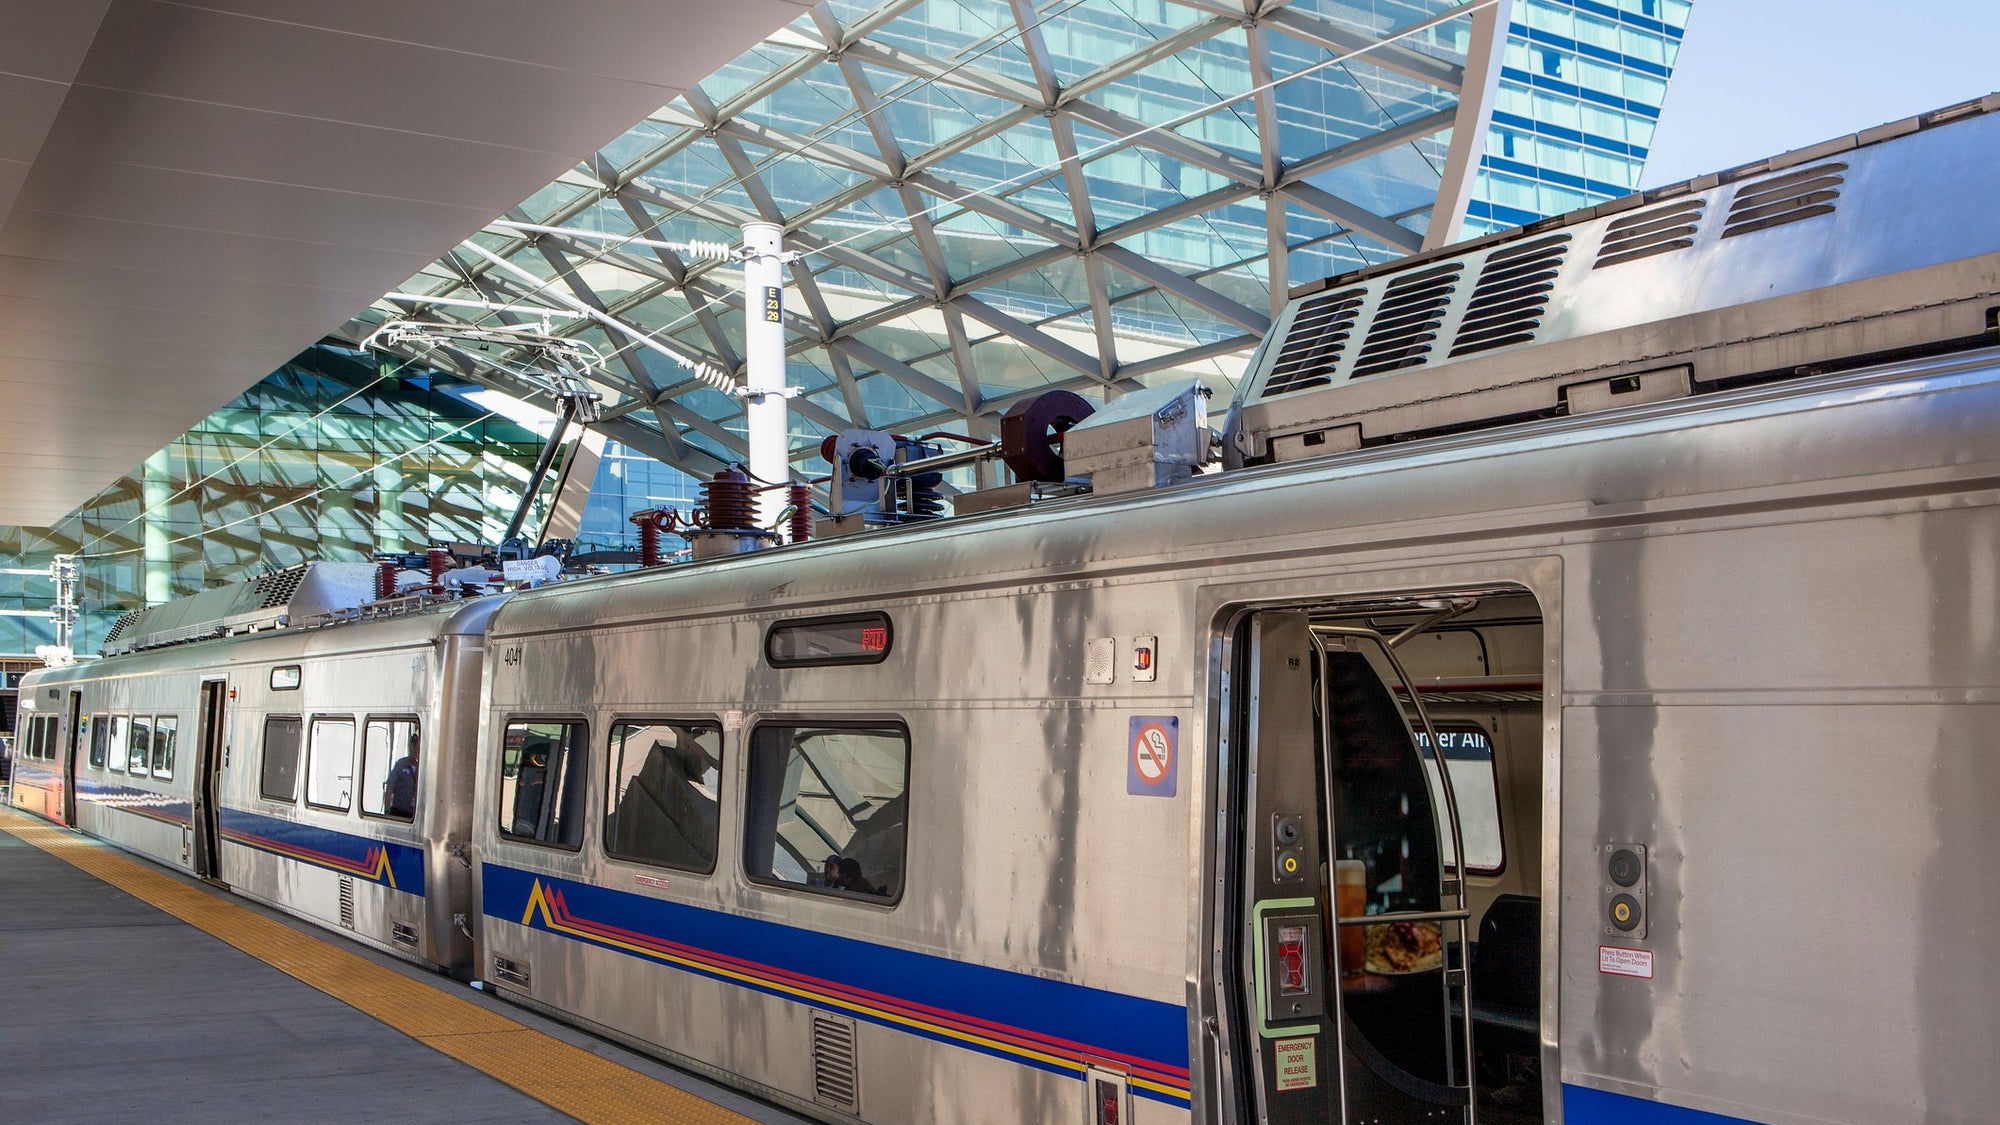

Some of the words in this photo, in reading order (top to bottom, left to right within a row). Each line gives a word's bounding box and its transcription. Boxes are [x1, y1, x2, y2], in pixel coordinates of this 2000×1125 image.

[768, 287, 776, 298] E
[766, 299, 778, 310] 23
[766, 310, 779, 321] 29
[504, 647, 522, 666] 4041
[1288, 657, 1300, 666] R2
[1616, 950, 1633, 958] Button
[1634, 952, 1650, 961] When
[1616, 957, 1631, 965] Open
[1632, 959, 1648, 967] Doors
[1278, 1042, 1312, 1052] EMERGENCY
[1287, 1054, 1304, 1063] DOOR
[1284, 1066, 1308, 1075] RELEASE
